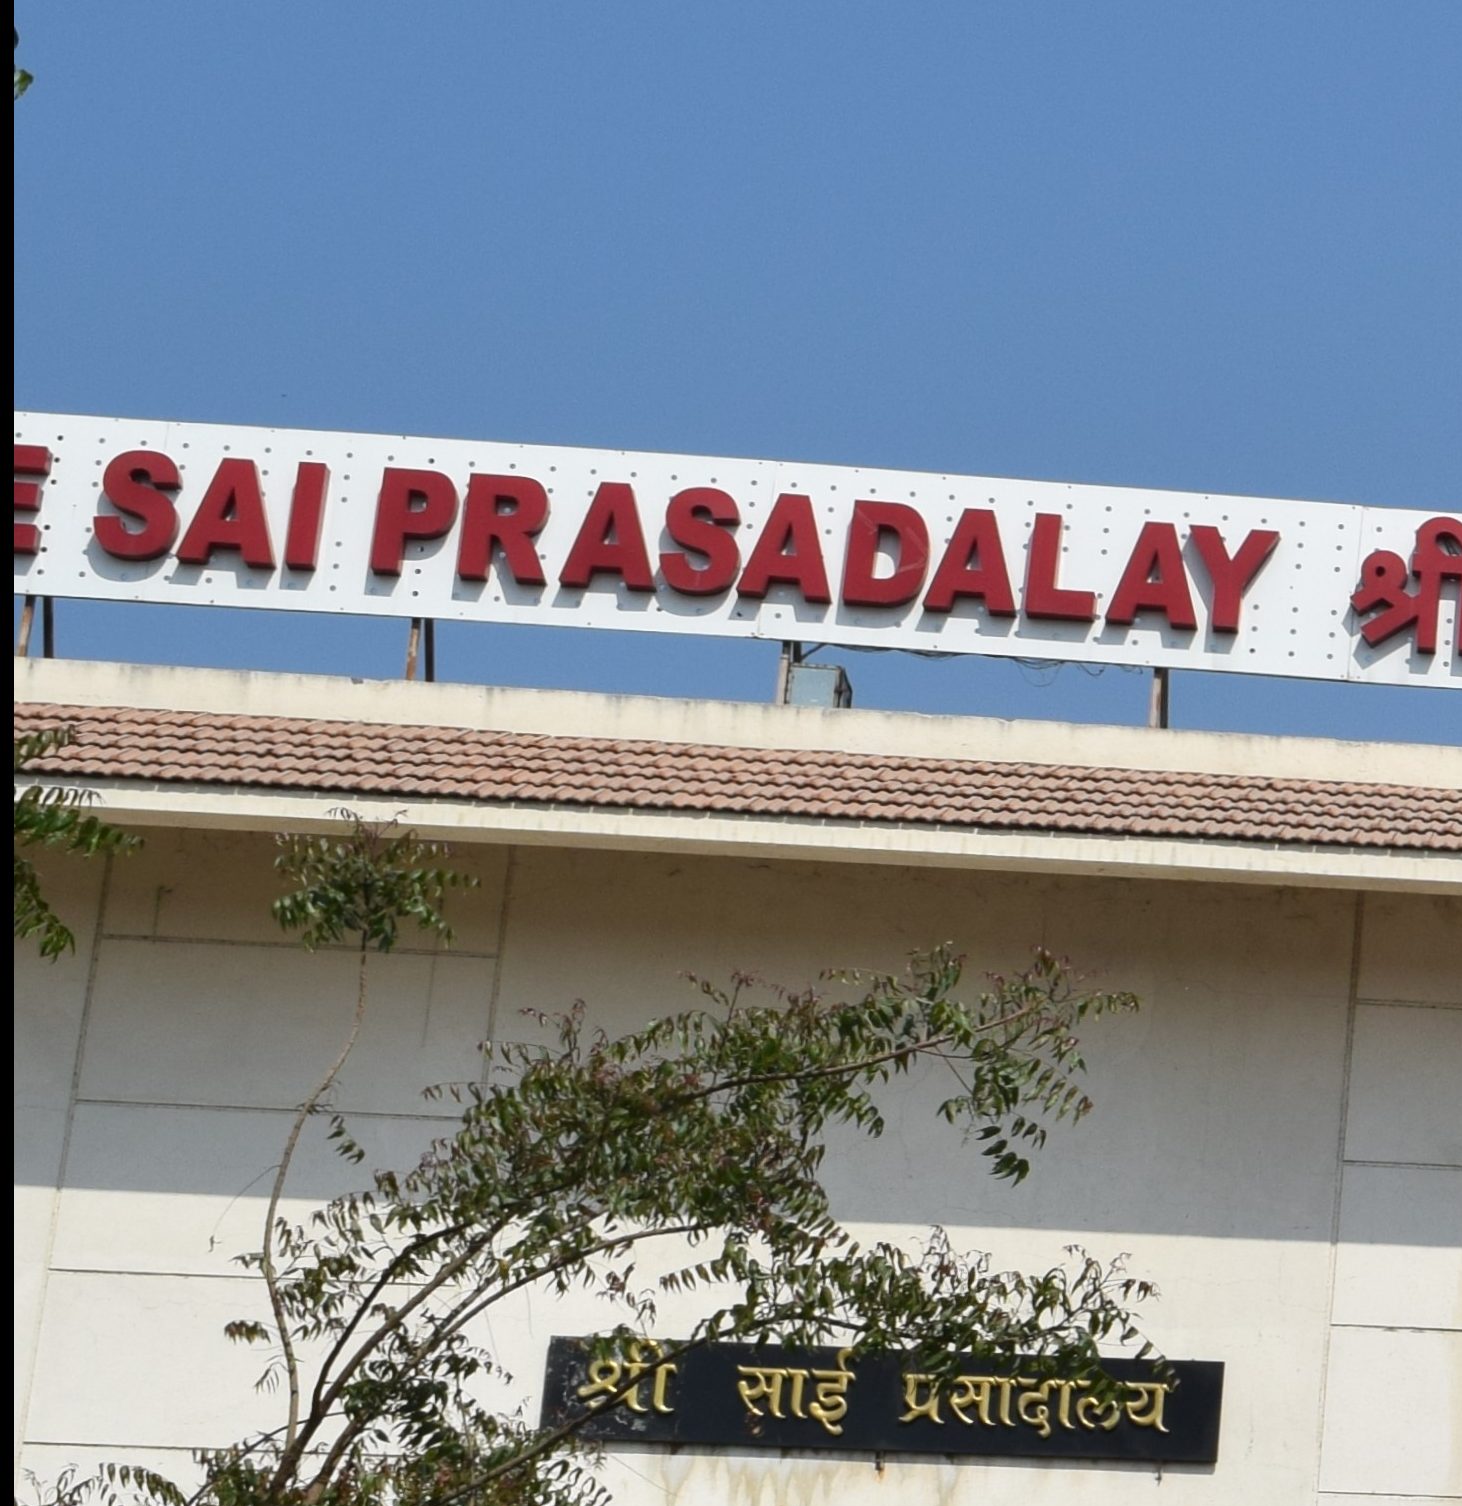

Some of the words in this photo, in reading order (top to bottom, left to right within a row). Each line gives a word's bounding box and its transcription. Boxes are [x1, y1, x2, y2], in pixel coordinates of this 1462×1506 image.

[93, 449, 331, 571] SAI
[370, 467, 1281, 634] PRASADALAY
[577, 1340, 677, 1414] श्री
[737, 1348, 856, 1436] साई
[898, 1373, 1171, 1439] प्रसादालय
